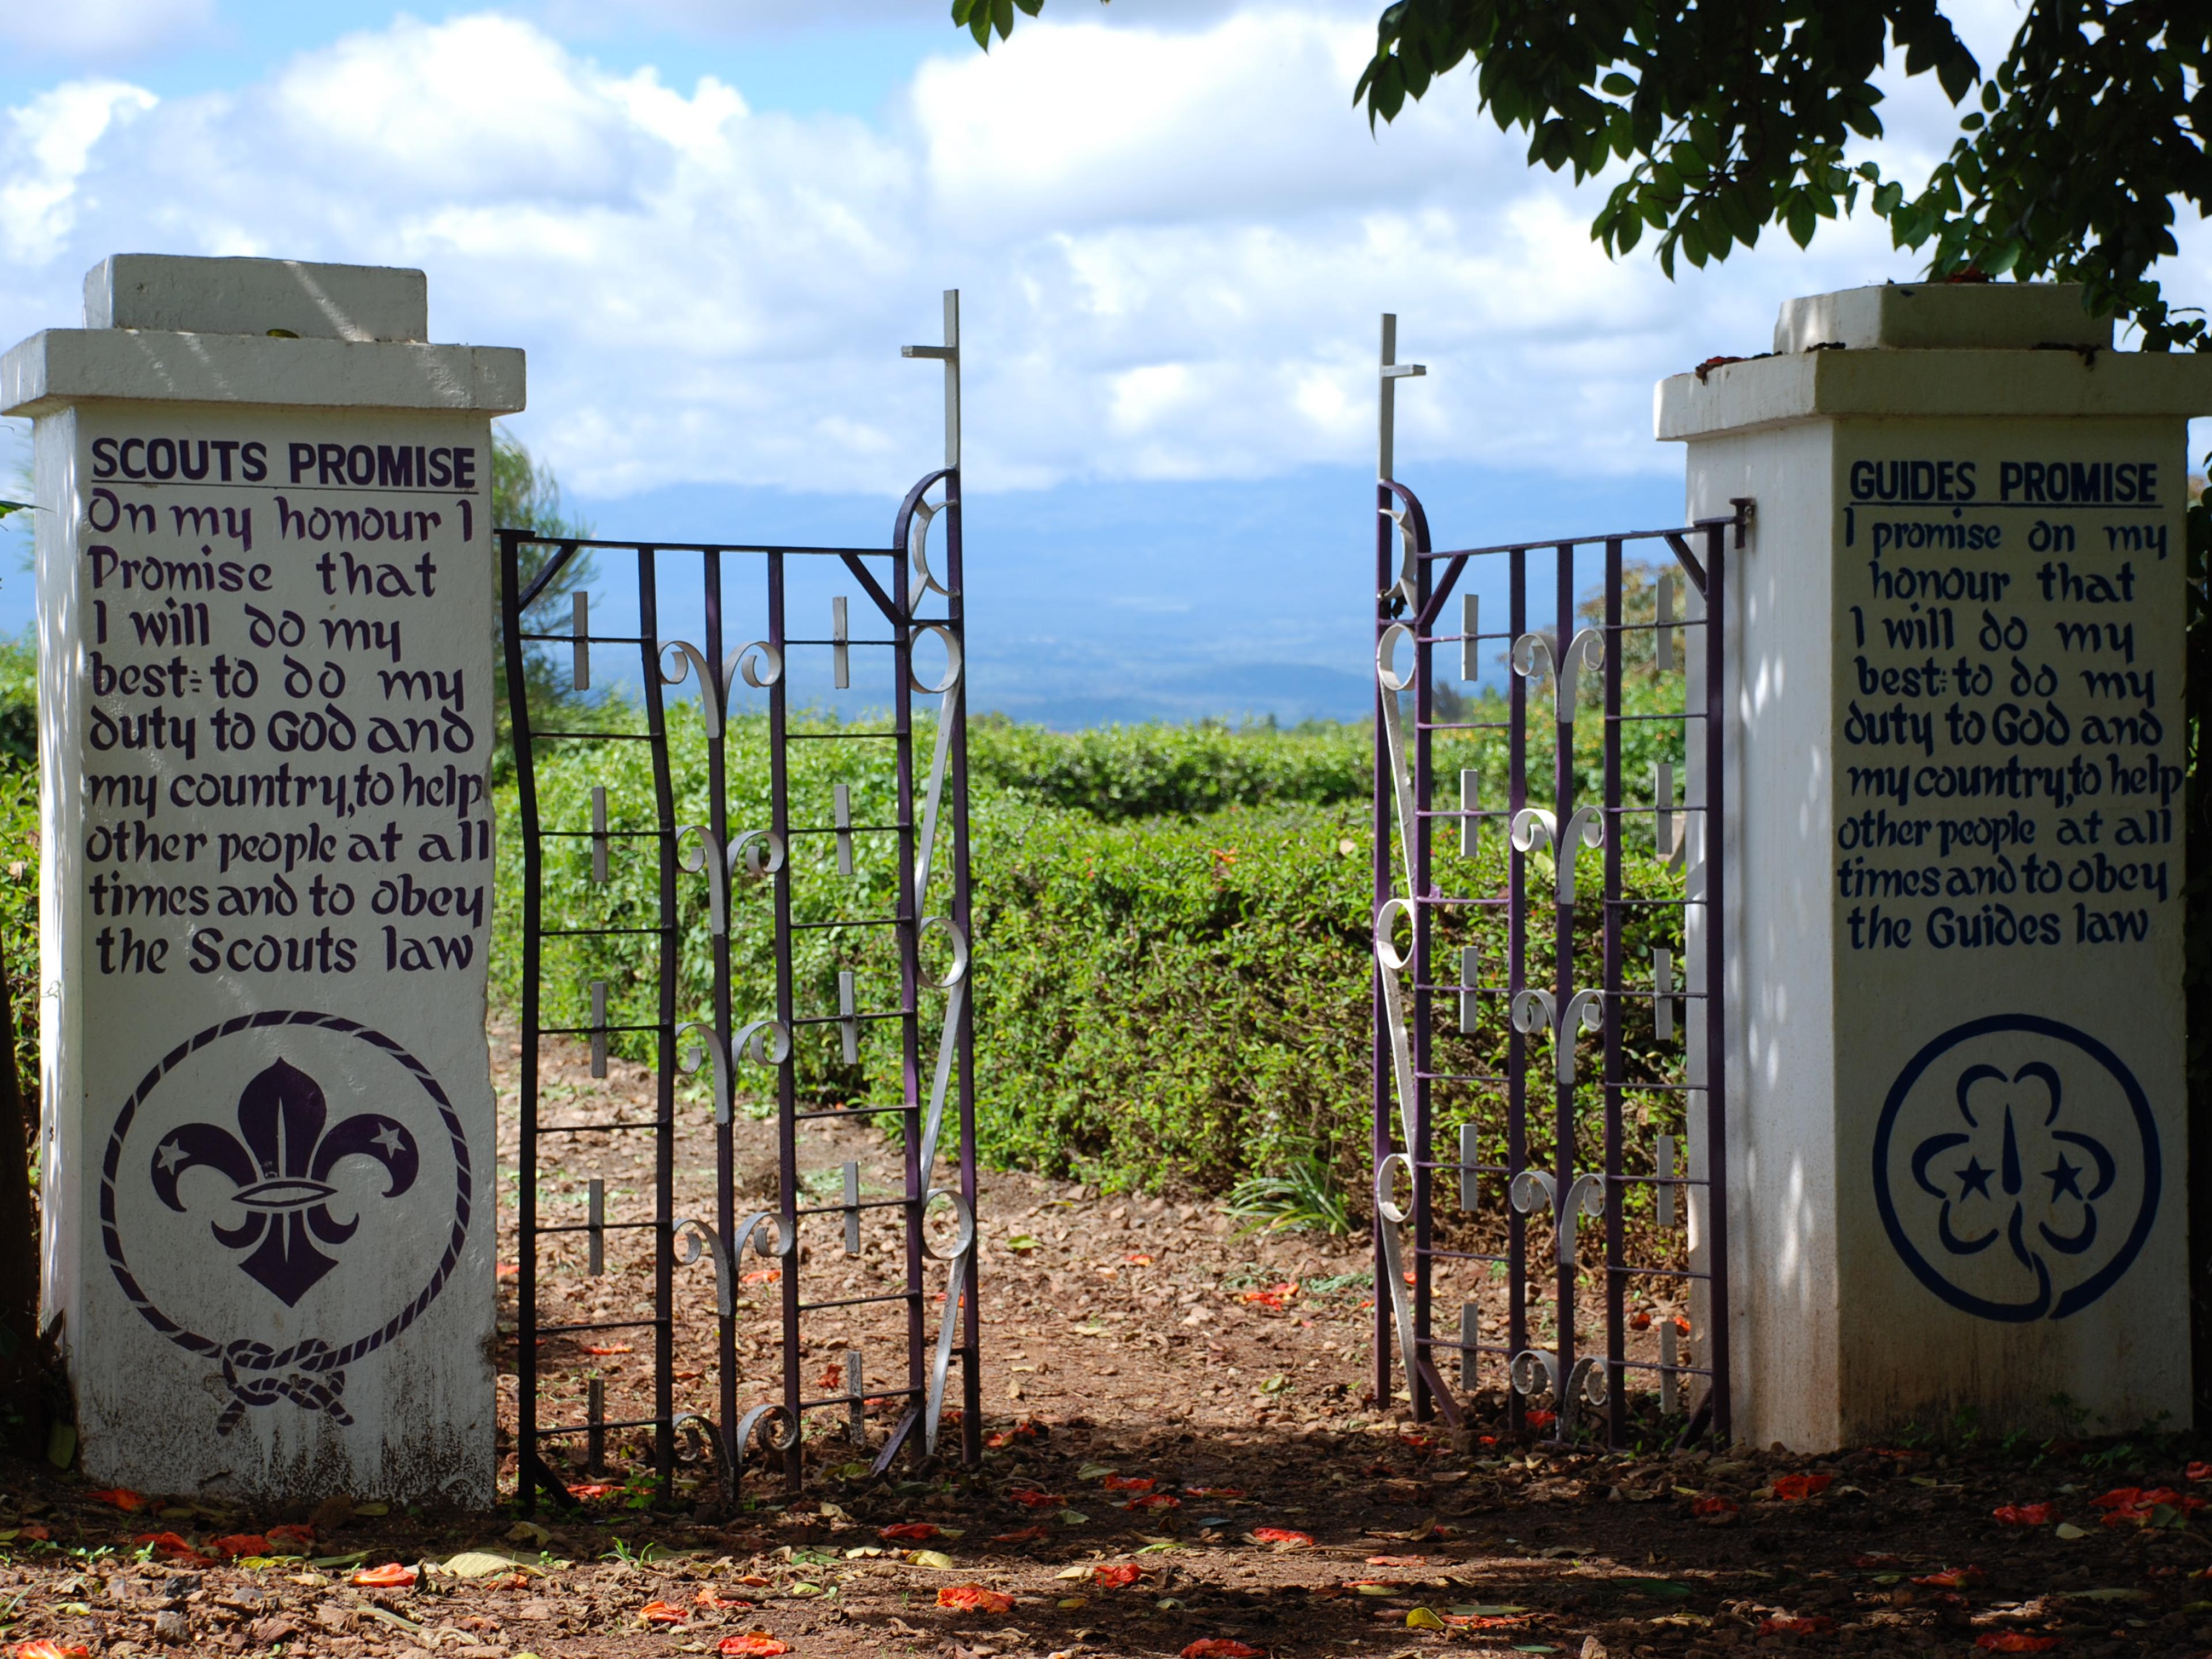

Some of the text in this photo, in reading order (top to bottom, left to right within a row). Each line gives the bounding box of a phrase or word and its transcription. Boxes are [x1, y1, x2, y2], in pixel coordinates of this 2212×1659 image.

[92, 438, 475, 488] SCOUTS PROMISE
[1850, 460, 2157, 502] GUIDES PROMISE
[89, 488, 472, 552] On my honour I
[1843, 507, 2167, 560] I promise on my
[87, 544, 436, 597] Promise that
[1868, 560, 2135, 603] honour that
[94, 597, 400, 663] I will do my
[1850, 602, 2134, 664] I will do my
[210, 654, 258, 698] to
[283, 654, 346, 698] do
[377, 668, 464, 711] my
[1952, 656, 1993, 696] to
[2010, 656, 2058, 696] do
[2080, 669, 2154, 708] my
[89, 702, 474, 760] duty to God and
[1844, 700, 2163, 757] duty to God and
[88, 774, 157, 819] my
[354, 764, 394, 806] to
[399, 763, 482, 818] help
[1847, 766, 1910, 806] my
[2068, 755, 2101, 792] to
[2106, 753, 2183, 806] help
[86, 820, 488, 873] other people at all
[1838, 809, 2172, 857] other people at all
[89, 870, 483, 929] times and to obey
[1837, 852, 2167, 903] times and to obey
[96, 925, 474, 974] the Scouts law
[1847, 902, 2149, 949] the Guides law
